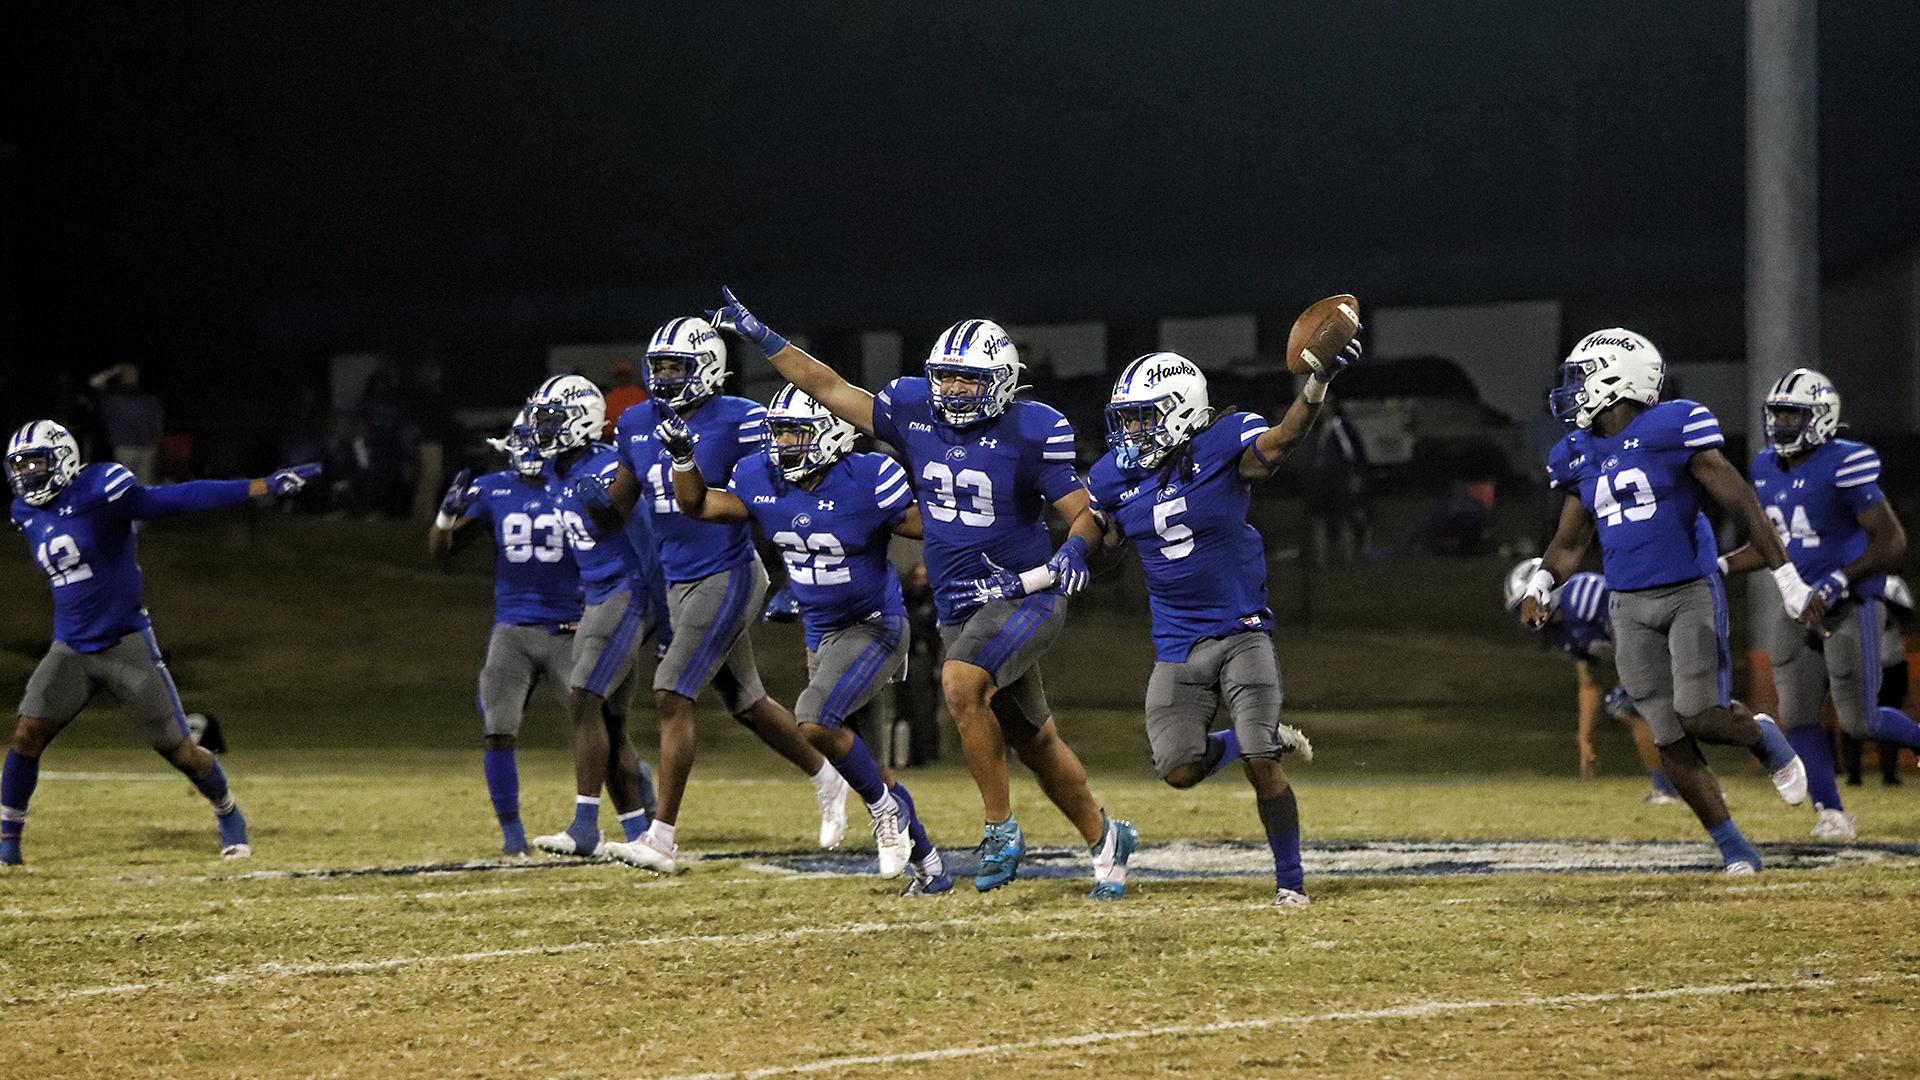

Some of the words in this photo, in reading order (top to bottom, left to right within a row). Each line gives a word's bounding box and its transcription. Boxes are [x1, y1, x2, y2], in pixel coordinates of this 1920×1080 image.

[1581, 334, 1636, 353] Hawks
[1144, 361, 1196, 389] Hawks
[909, 421, 932, 433] CIAA
[647, 463, 680, 514] 1
[753, 495, 777, 504] CIAA
[923, 461, 996, 528] 33
[1120, 486, 1140, 501] CIAA
[1594, 467, 1657, 527] 43
[502, 512, 564, 564] 83
[1153, 496, 1196, 560] 5
[37, 534, 94, 588] 12
[772, 531, 852, 585] 22
